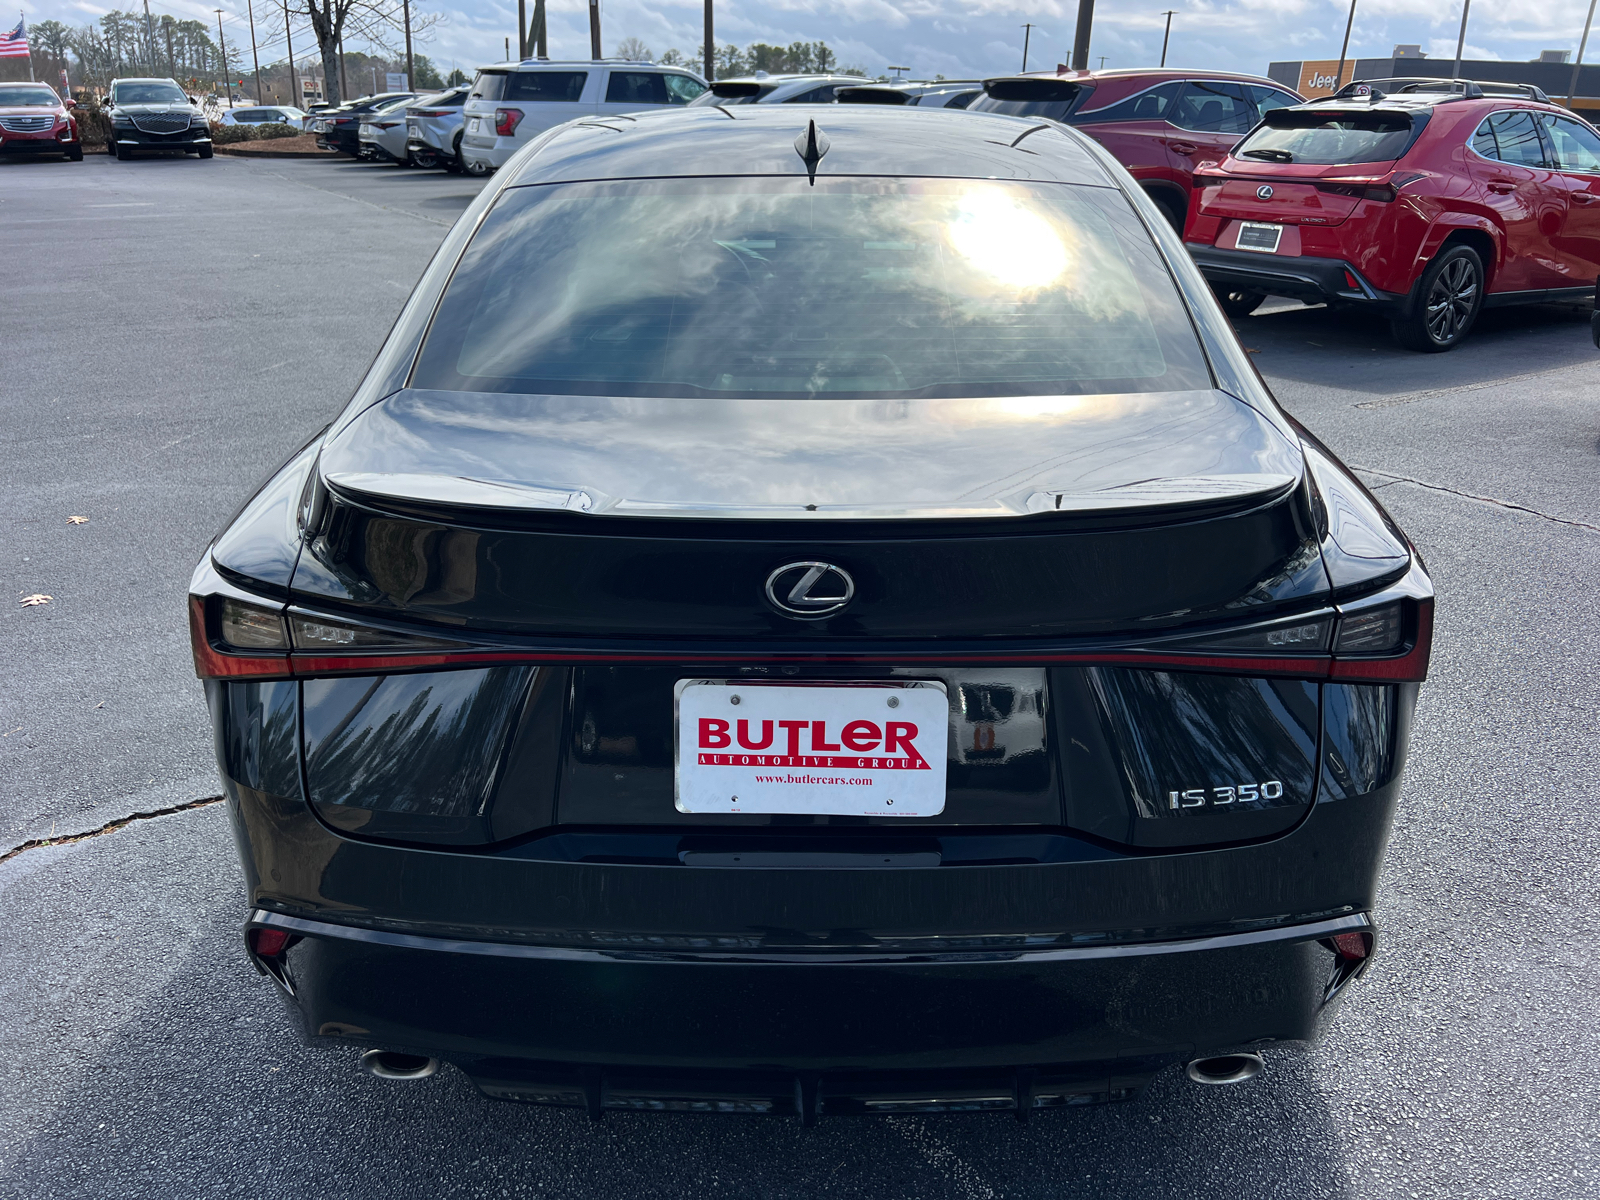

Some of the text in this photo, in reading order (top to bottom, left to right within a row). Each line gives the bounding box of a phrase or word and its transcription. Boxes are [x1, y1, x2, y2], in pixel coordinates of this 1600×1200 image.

[699, 754, 923, 769] AUTOMOTIVE GROUP
[755, 774, 873, 786] www.butlercars.com
[1169, 780, 1284, 810] IS 350
